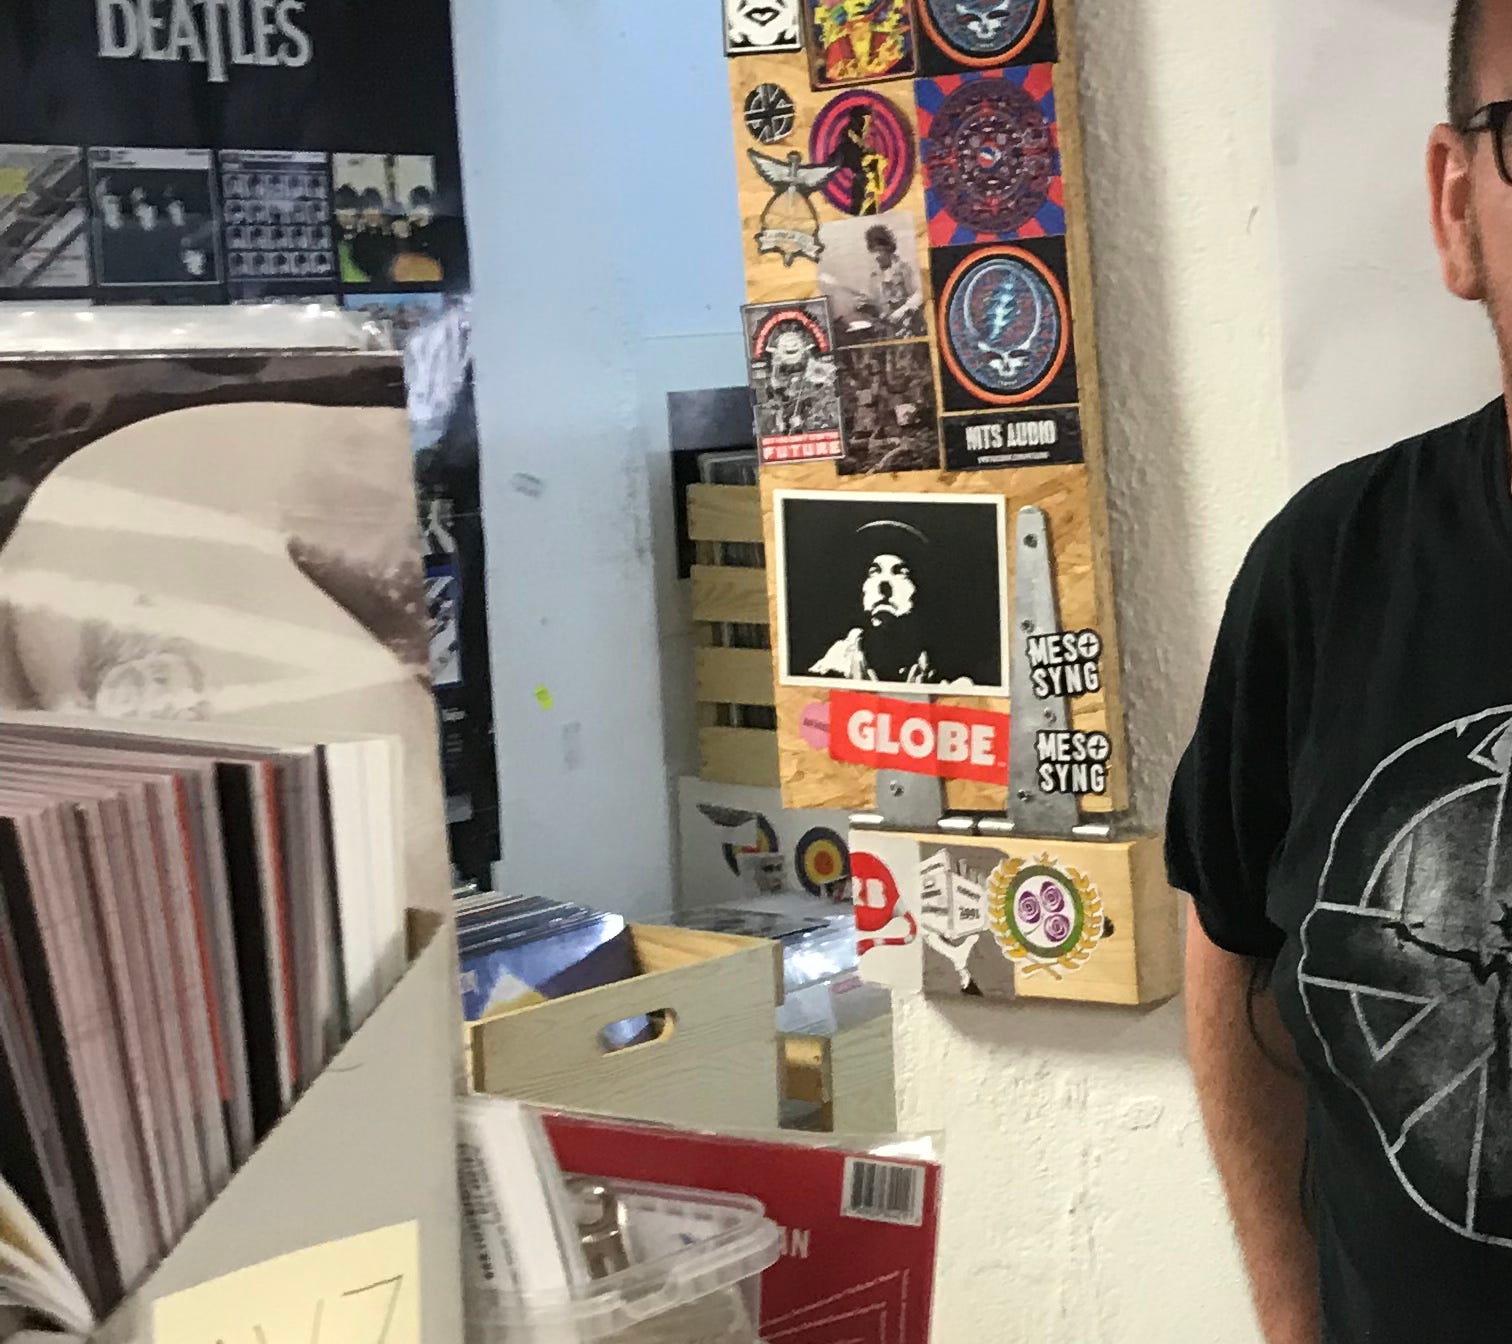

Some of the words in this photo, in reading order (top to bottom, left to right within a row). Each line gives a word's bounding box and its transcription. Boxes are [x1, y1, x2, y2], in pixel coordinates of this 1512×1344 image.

[1032, 662, 1099, 699] SYNG
[847, 709, 996, 767] GLOBE
[1039, 763, 1107, 794] SYNG
